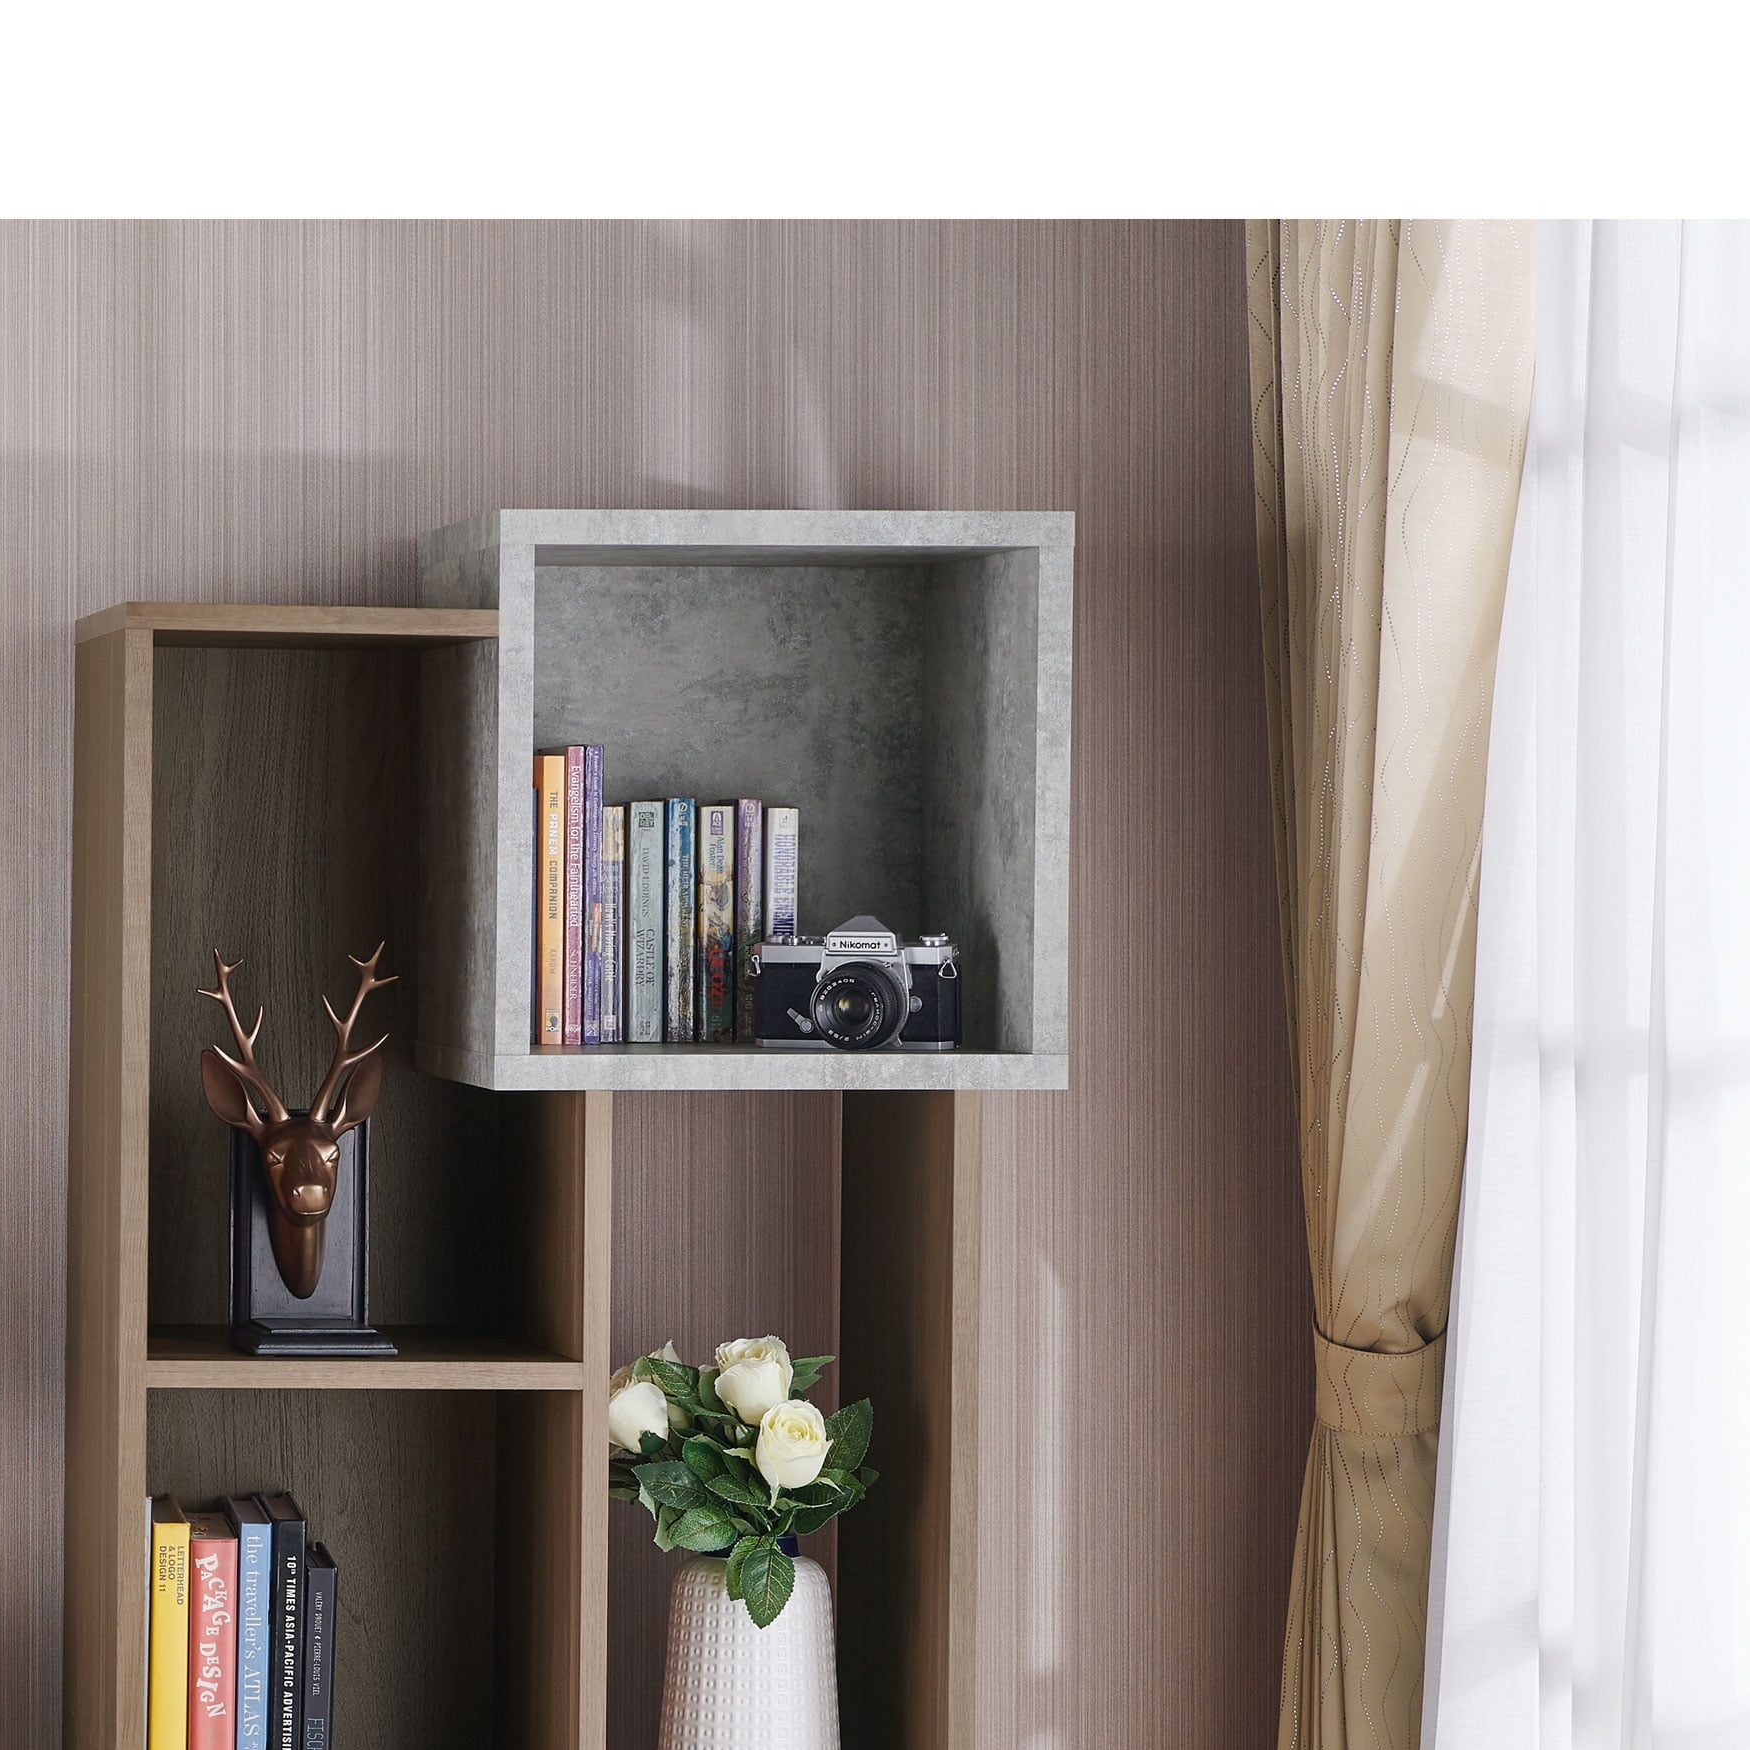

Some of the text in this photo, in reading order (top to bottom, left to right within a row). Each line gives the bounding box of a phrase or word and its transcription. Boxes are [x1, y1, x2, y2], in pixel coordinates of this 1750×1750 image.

[549, 791, 559, 809] THE
[569, 765, 582, 927] Evangelism for the Fainthearted
[709, 843, 717, 866] Foster
[716, 836, 725, 854] Alan
[716, 855, 725, 874] Dean
[548, 860, 558, 920] COMPANION
[641, 848, 650, 917] DAVID EDDINGS
[773, 834, 796, 936] HONORABLE ENEMIE
[602, 929, 616, 957] Moving
[636, 929, 645, 987] WIZARDRY
[646, 929, 655, 986] CASTLE OF
[839, 940, 881, 949] Nikomat
[158, 1545, 167, 1592] DESIGN 11
[168, 1554, 176, 1580] LOGO
[176, 1545, 184, 1605] LETTERHEAD
[285, 1578, 297, 1611] TIMES
[195, 1553, 231, 1718] PACKAGE DESIGN
[243, 1535, 264, 1736] the traveller's ATLAS
[284, 1615, 295, 1687] ASIA-PACIFIC
[312, 1642, 322, 1681] PIERRE-LOUIS
[312, 1682, 321, 1696] VIEL
